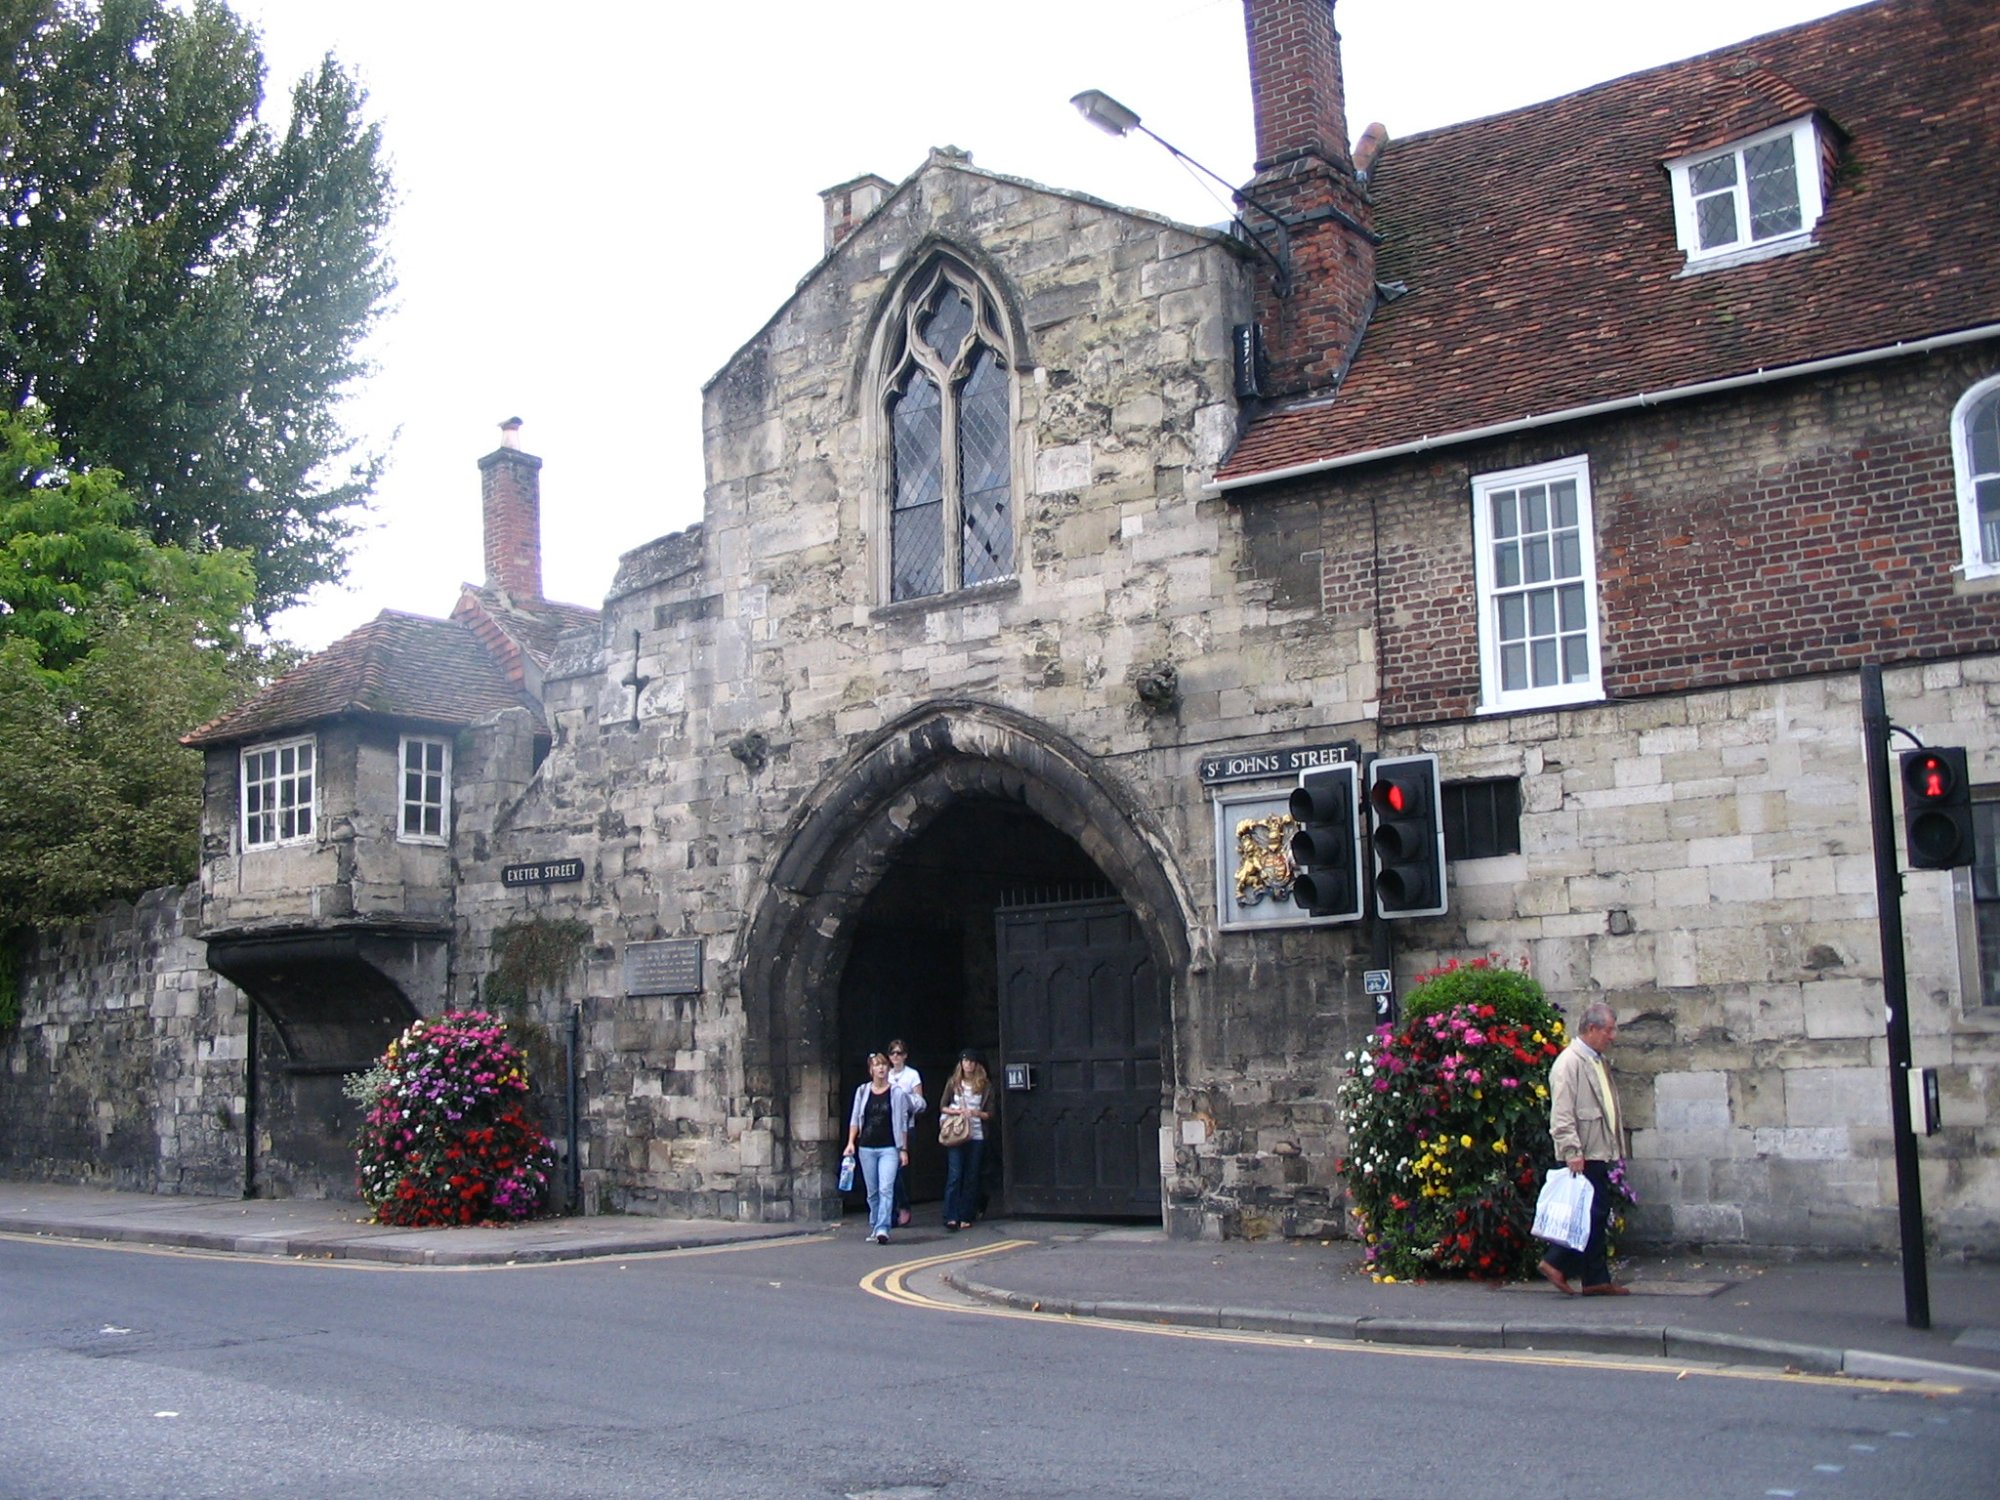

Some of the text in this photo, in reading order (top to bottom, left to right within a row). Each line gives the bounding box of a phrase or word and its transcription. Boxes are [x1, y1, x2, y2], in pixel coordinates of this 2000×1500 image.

[1290, 747, 1348, 768] STREET
[507, 863, 577, 882] EXETER STREET
